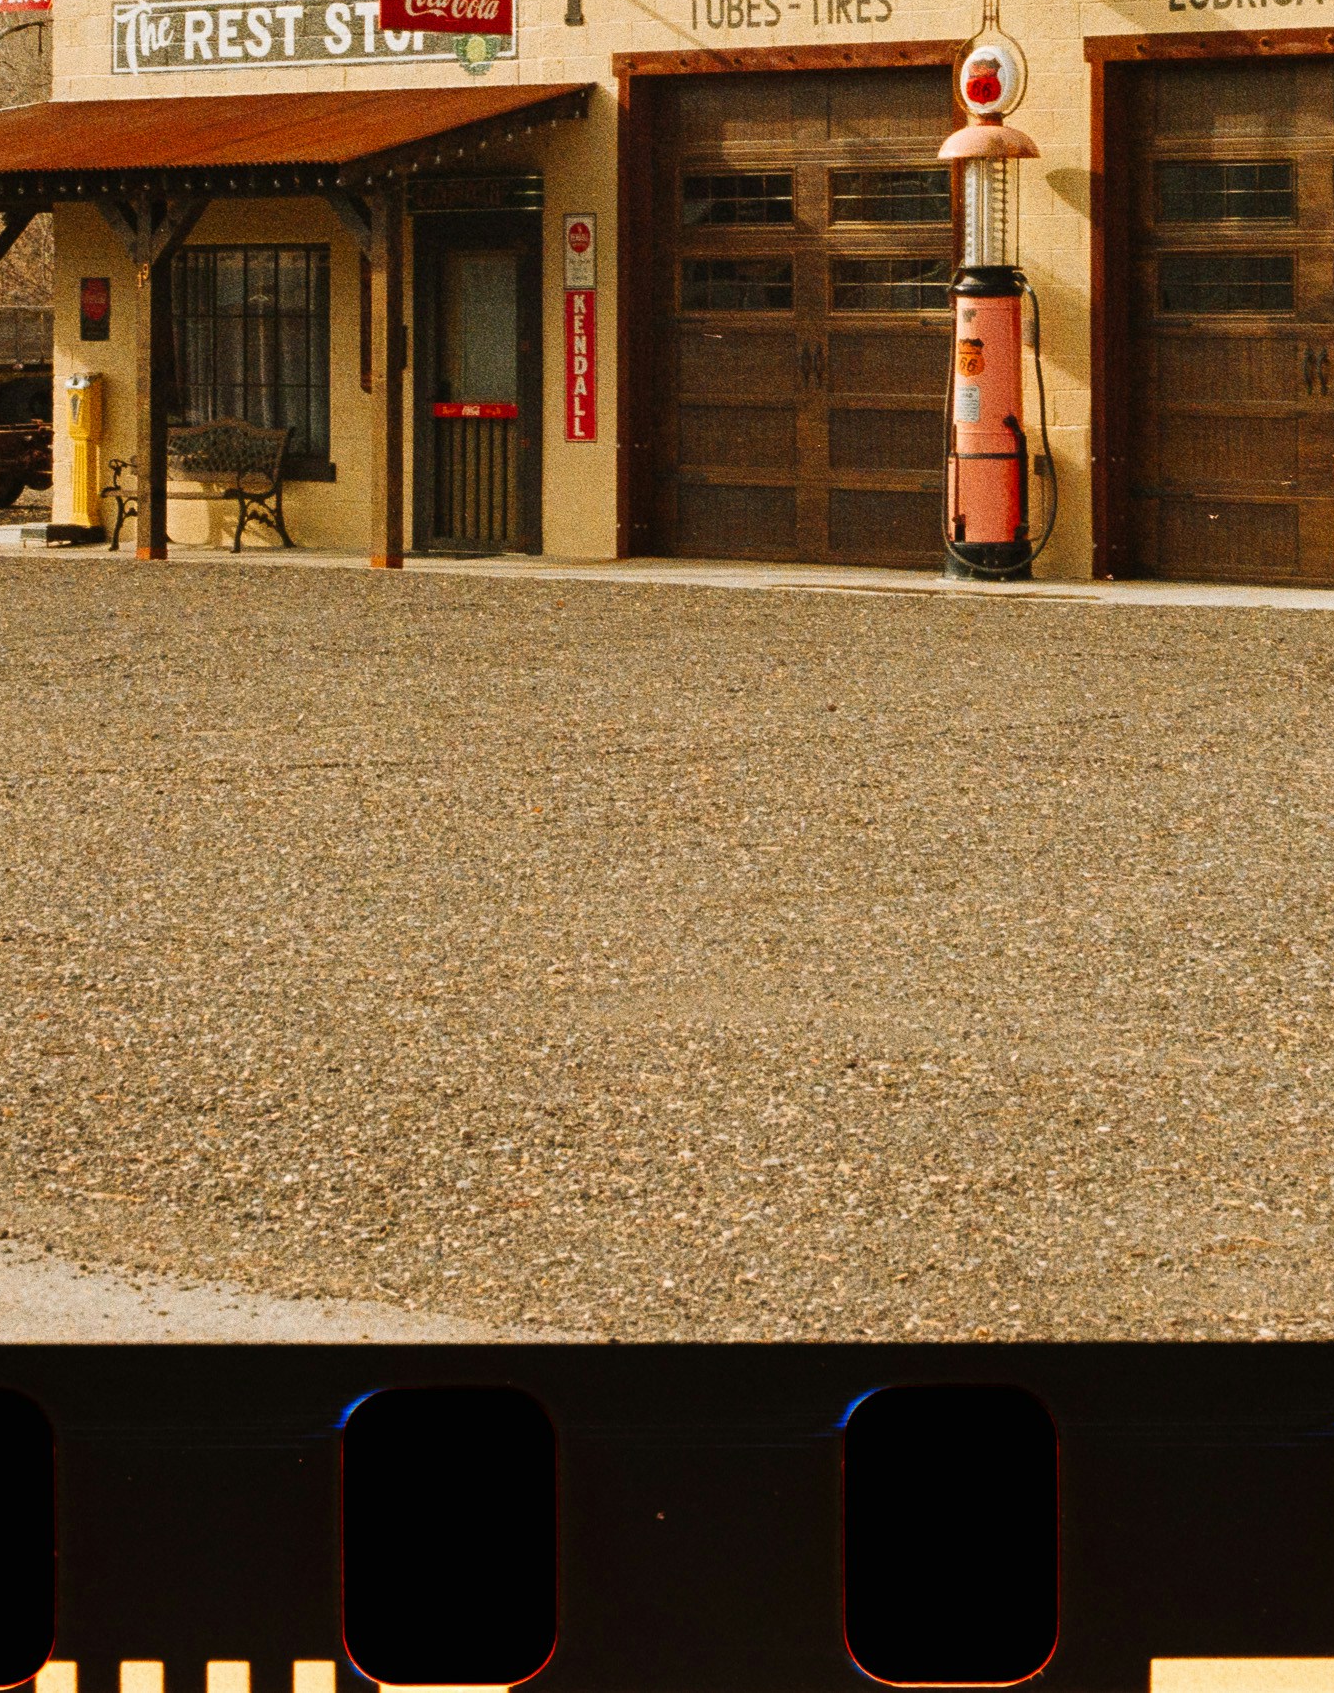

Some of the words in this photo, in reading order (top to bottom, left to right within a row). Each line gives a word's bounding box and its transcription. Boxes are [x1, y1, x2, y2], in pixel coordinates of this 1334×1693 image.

[114, 0, 173, 75] The
[184, 5, 304, 60] REST
[972, 79, 992, 98] 66
[573, 294, 588, 437] KENDALL
[960, 356, 978, 373] 66
